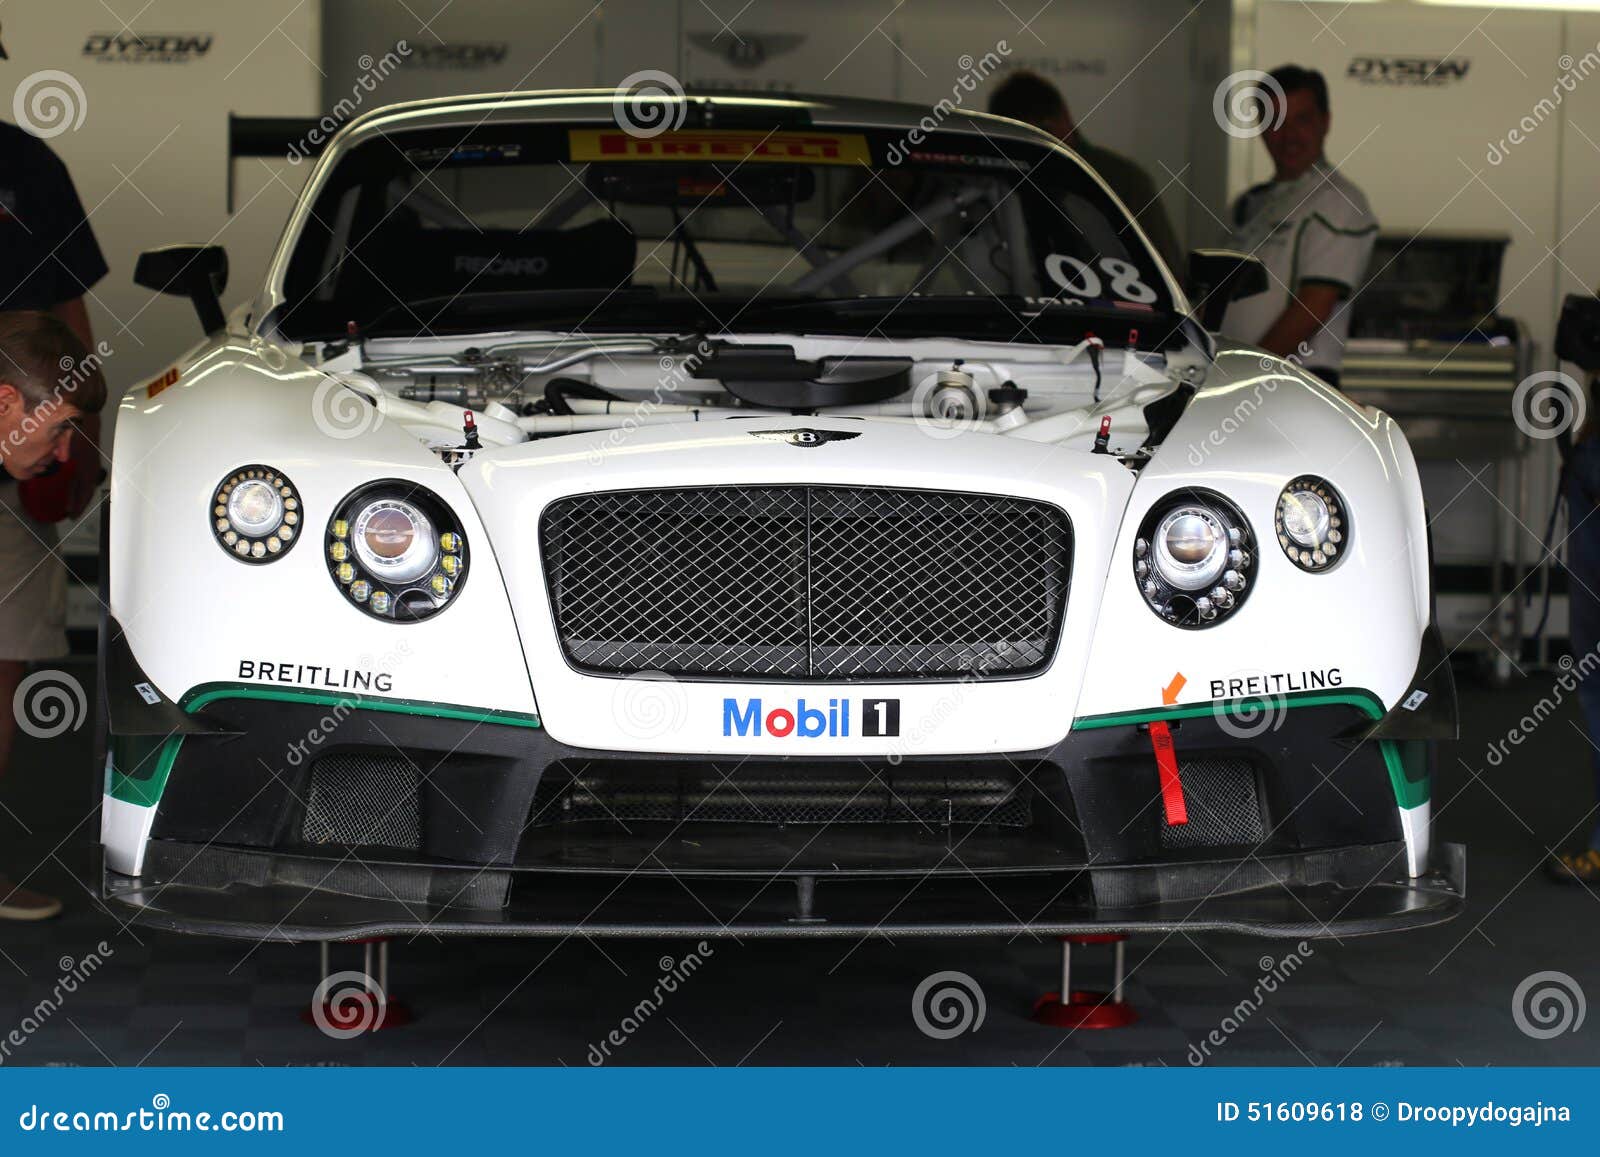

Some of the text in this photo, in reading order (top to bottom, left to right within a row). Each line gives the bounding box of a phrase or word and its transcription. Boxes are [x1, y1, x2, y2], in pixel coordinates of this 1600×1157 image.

[82, 33, 213, 56] DYSON
[1345, 57, 1471, 79] DYSON
[600, 134, 840, 158] PIRELLI
[455, 256, 548, 275] RECARO
[1044, 253, 1158, 304] 08
[238, 660, 393, 692] BREITLING
[1210, 668, 1342, 698] BREITLING
[723, 698, 850, 738] Mobil
